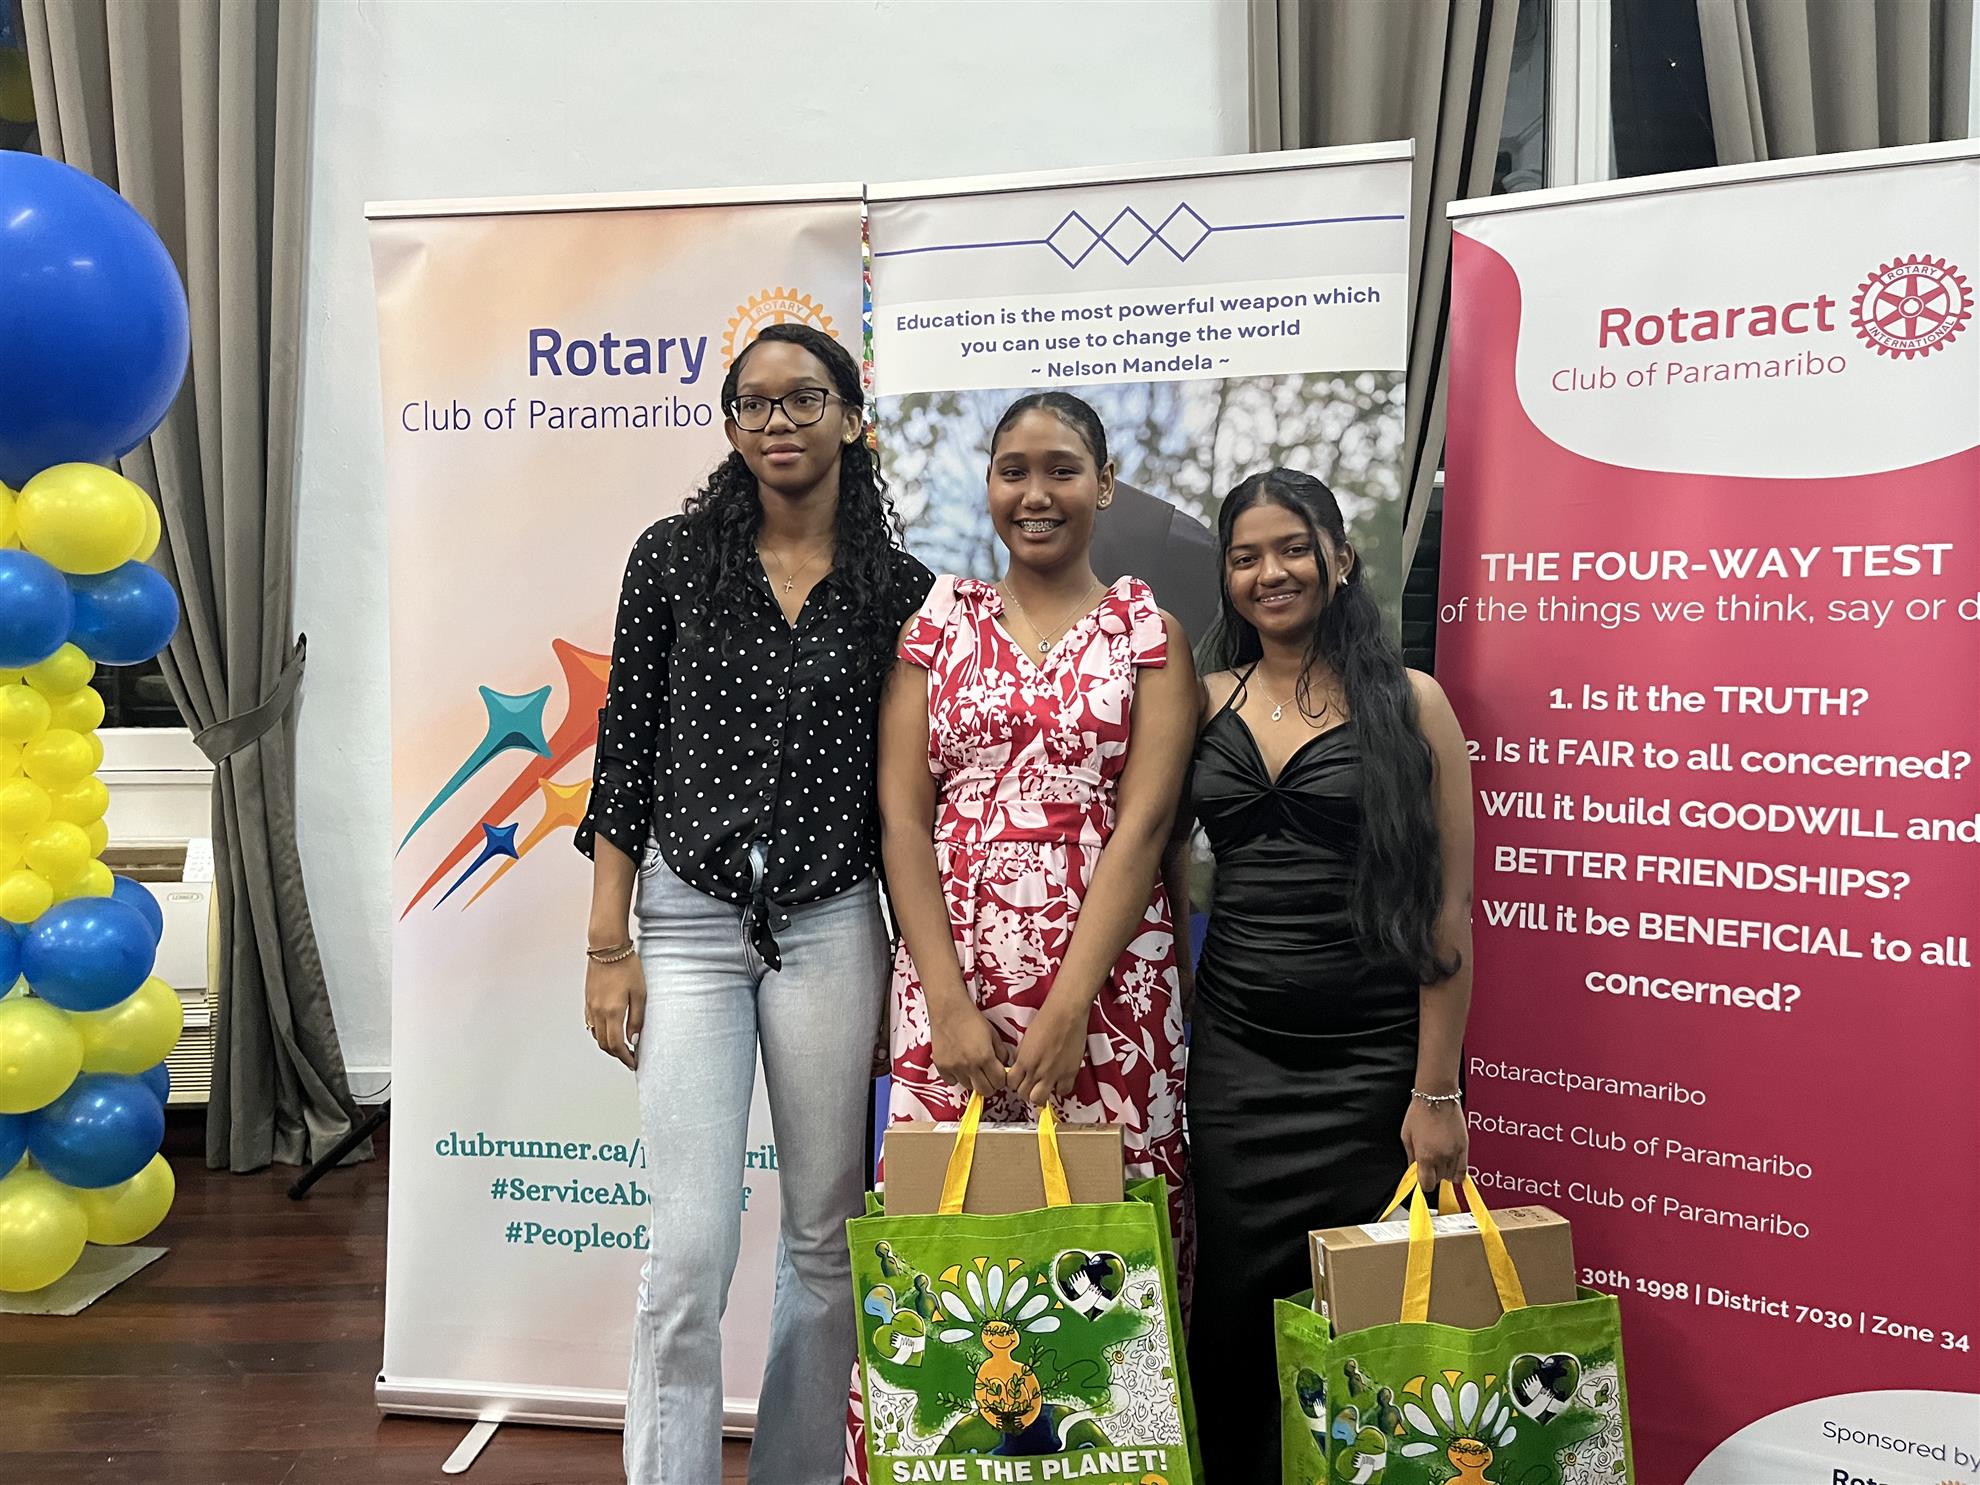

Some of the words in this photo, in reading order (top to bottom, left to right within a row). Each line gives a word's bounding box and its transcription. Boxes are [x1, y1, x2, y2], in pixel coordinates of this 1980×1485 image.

[1886, 264, 1939, 281] ROTARY
[755, 300, 805, 317] ROTARY
[897, 309, 995, 331] Education
[1000, 307, 1016, 325] is
[1020, 307, 1056, 323] the
[1061, 304, 1113, 322] most
[1118, 296, 1214, 322] powerful
[1219, 294, 1307, 313] weapon
[1313, 286, 1380, 305] which
[1599, 294, 1836, 349] Rotaract
[960, 340, 997, 358] you
[1002, 338, 1040, 352] can
[1045, 336, 1081, 350] use
[1085, 333, 1108, 348] to
[1112, 329, 1192, 348] change
[1196, 324, 1232, 342] the
[1237, 319, 1300, 339] world
[1868, 319, 1955, 350] INTERNATIONAL
[529, 328, 708, 385] Rotary
[1048, 360, 1117, 378] Nelson
[1123, 354, 1213, 374] Mandela
[1552, 365, 1617, 392] Club
[1626, 361, 1658, 388] of
[1667, 350, 1846, 385] Paramaribo
[402, 399, 471, 432] Club
[484, 398, 517, 430] of
[530, 395, 712, 430] Paramaribo
[1480, 552, 1560, 582] THE
[1572, 546, 1822, 581] FOUR-WAY
[1832, 543, 1954, 577] TEST
[1440, 596, 1469, 623] of
[1476, 595, 1528, 622] the
[1537, 595, 1641, 630] things
[1651, 601, 1705, 622] we
[1715, 593, 1814, 624] think,
[1827, 599, 1894, 629] say
[1905, 598, 1947, 621] or
[1957, 591, 1980, 621] d
[1549, 688, 1573, 710] 1.
[1582, 684, 1609, 711] Is
[1616, 684, 1639, 712] it
[1646, 684, 1706, 713] the
[1713, 686, 1869, 716] TRUTH?
[1495, 736, 1521, 763] Is
[1528, 737, 1550, 764] it
[1557, 739, 1635, 768] FAIR
[1642, 742, 1679, 770] to
[1686, 743, 1734, 772] all
[1740, 750, 1971, 780] concerned?
[1479, 790, 1547, 820] Will
[1553, 793, 1575, 821] it
[1582, 794, 1671, 827] build
[1679, 800, 1899, 839] GOODWILL
[1906, 813, 1980, 843] and
[1494, 845, 1627, 881] BETTER
[1636, 854, 1911, 901] FRIENDSHIPS?
[1481, 899, 1549, 931] Will
[1556, 904, 1578, 933] it
[1585, 907, 1631, 938] be
[1638, 912, 1863, 959] BENEFICIAL
[1870, 931, 1912, 962] to
[1920, 936, 1971, 968] all
[1585, 971, 1801, 1013] concerned?
[1470, 1057, 1706, 1106] Rotaractparamaribo
[1467, 1111, 1564, 1143] Rotaract
[1570, 1126, 1627, 1152] Club
[1633, 1136, 1660, 1157] of
[1665, 1139, 1812, 1179] Paramaribo
[1466, 1166, 1561, 1198] Rotaract
[1568, 1182, 1624, 1209] Club
[1631, 1194, 1658, 1214] of
[1663, 1196, 1810, 1239] Paramaribo
[505, 1221, 651, 1253] #Peopleof
[1579, 1267, 1630, 1290] 30th
[1636, 1278, 1689, 1300] 1998
[1707, 1287, 1790, 1318] District
[1795, 1305, 1853, 1329] 7030
[1871, 1315, 1935, 1343] Zone
[1940, 1331, 1970, 1353] 34
[892, 1458, 968, 1483] SAVE
[975, 1458, 1034, 1483] THE
[1041, 1449, 1168, 1481] PLANET!
[1822, 1421, 1946, 1462] Sponsored
[1954, 1446, 1980, 1473] by
